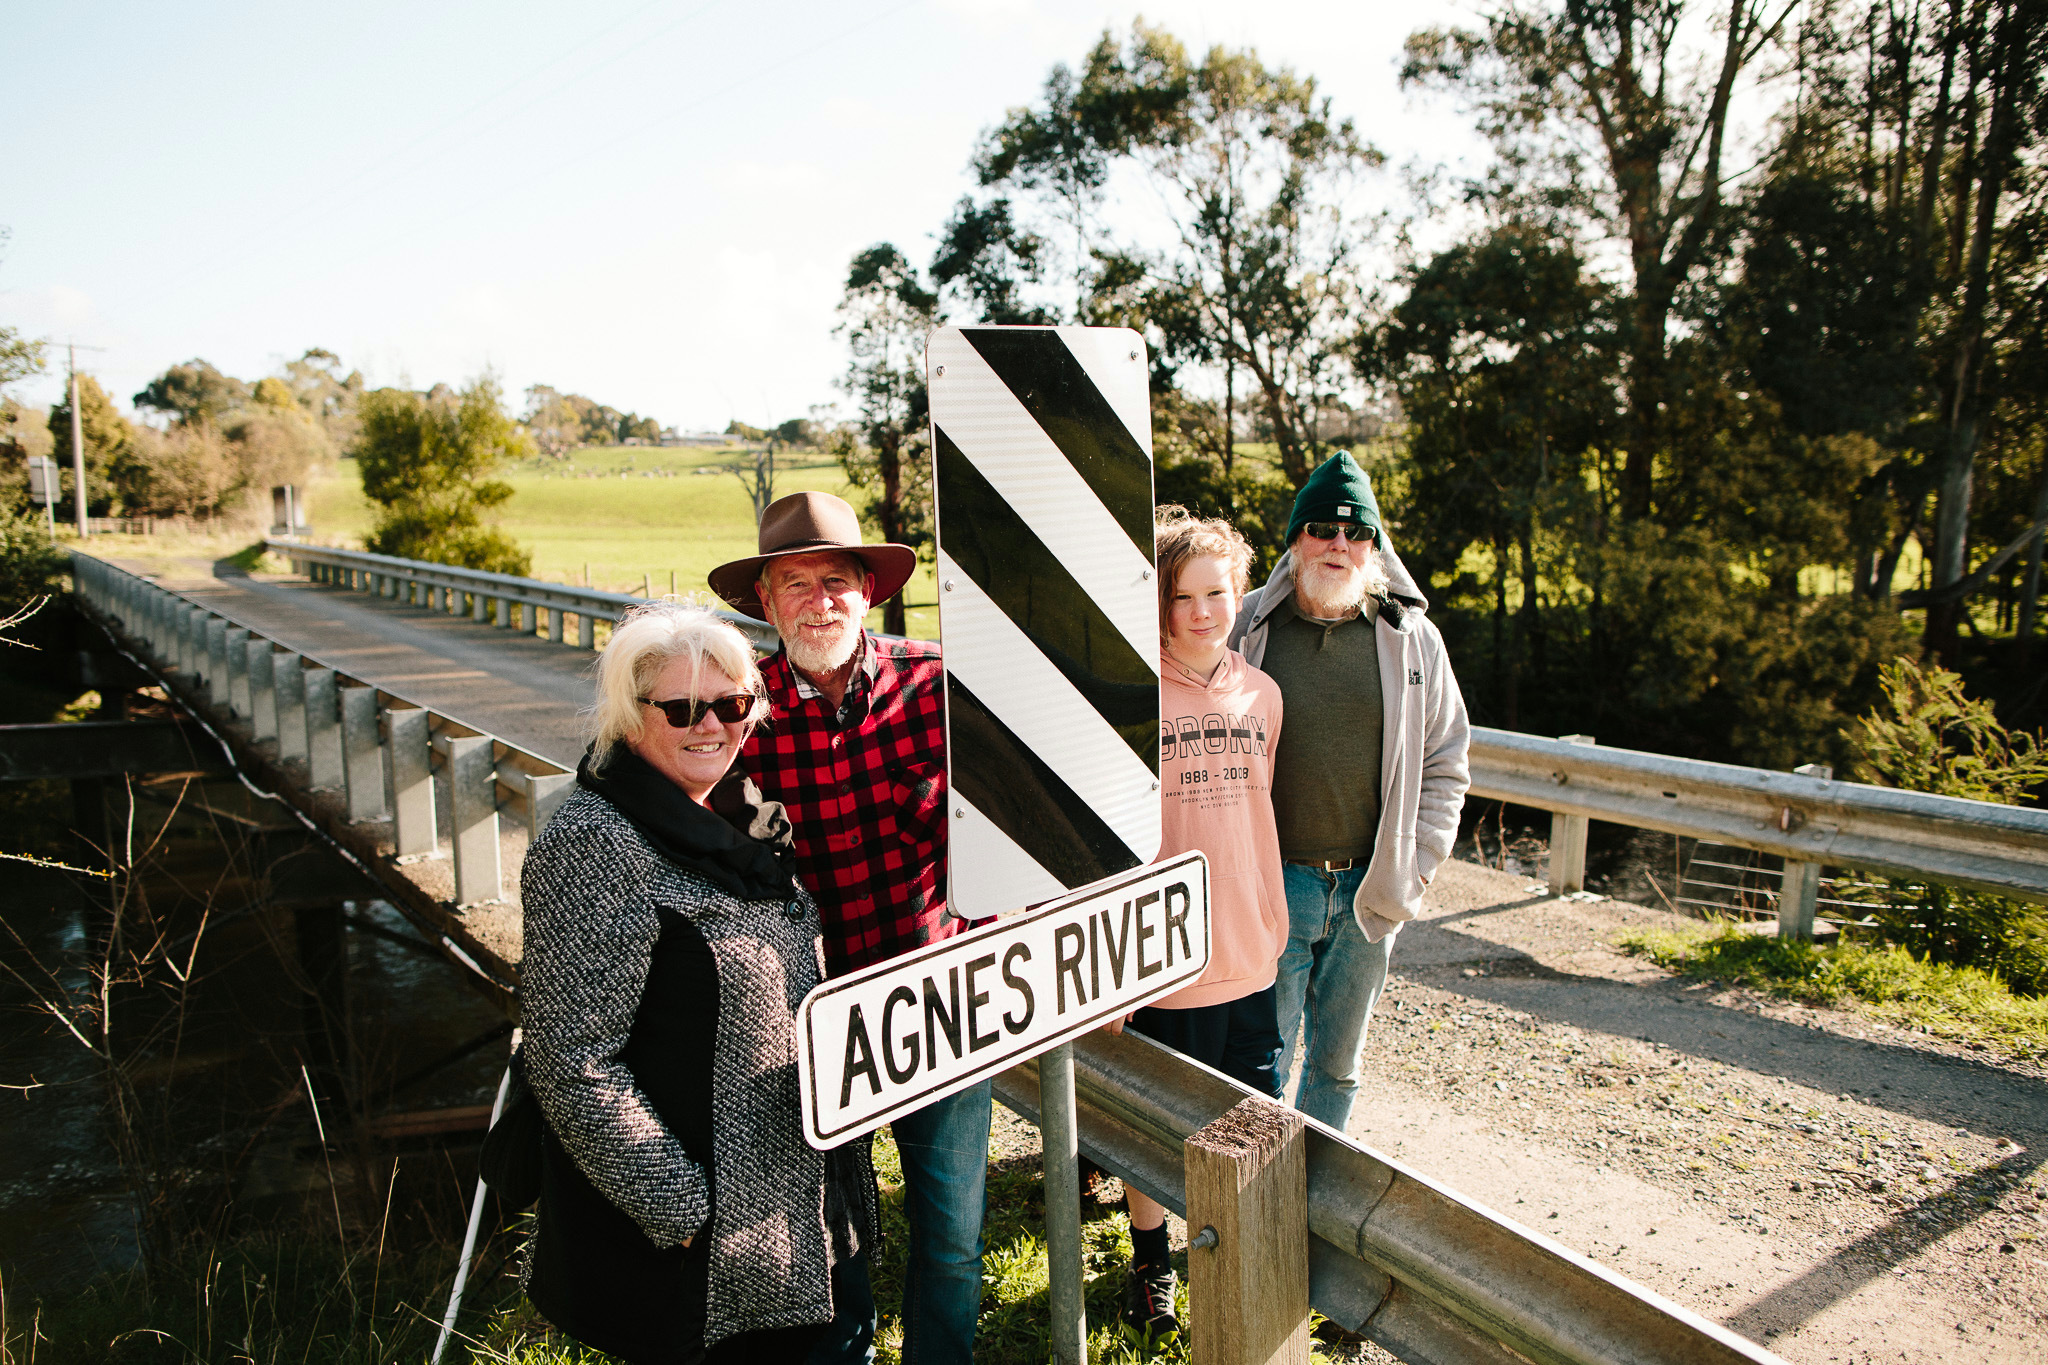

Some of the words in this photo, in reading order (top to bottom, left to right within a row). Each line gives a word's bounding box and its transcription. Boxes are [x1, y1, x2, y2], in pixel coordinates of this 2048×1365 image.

[1180, 769, 1209, 785] 1988
[838, 941, 1034, 1110] AGNES
[1054, 880, 1192, 1016] RIVER
